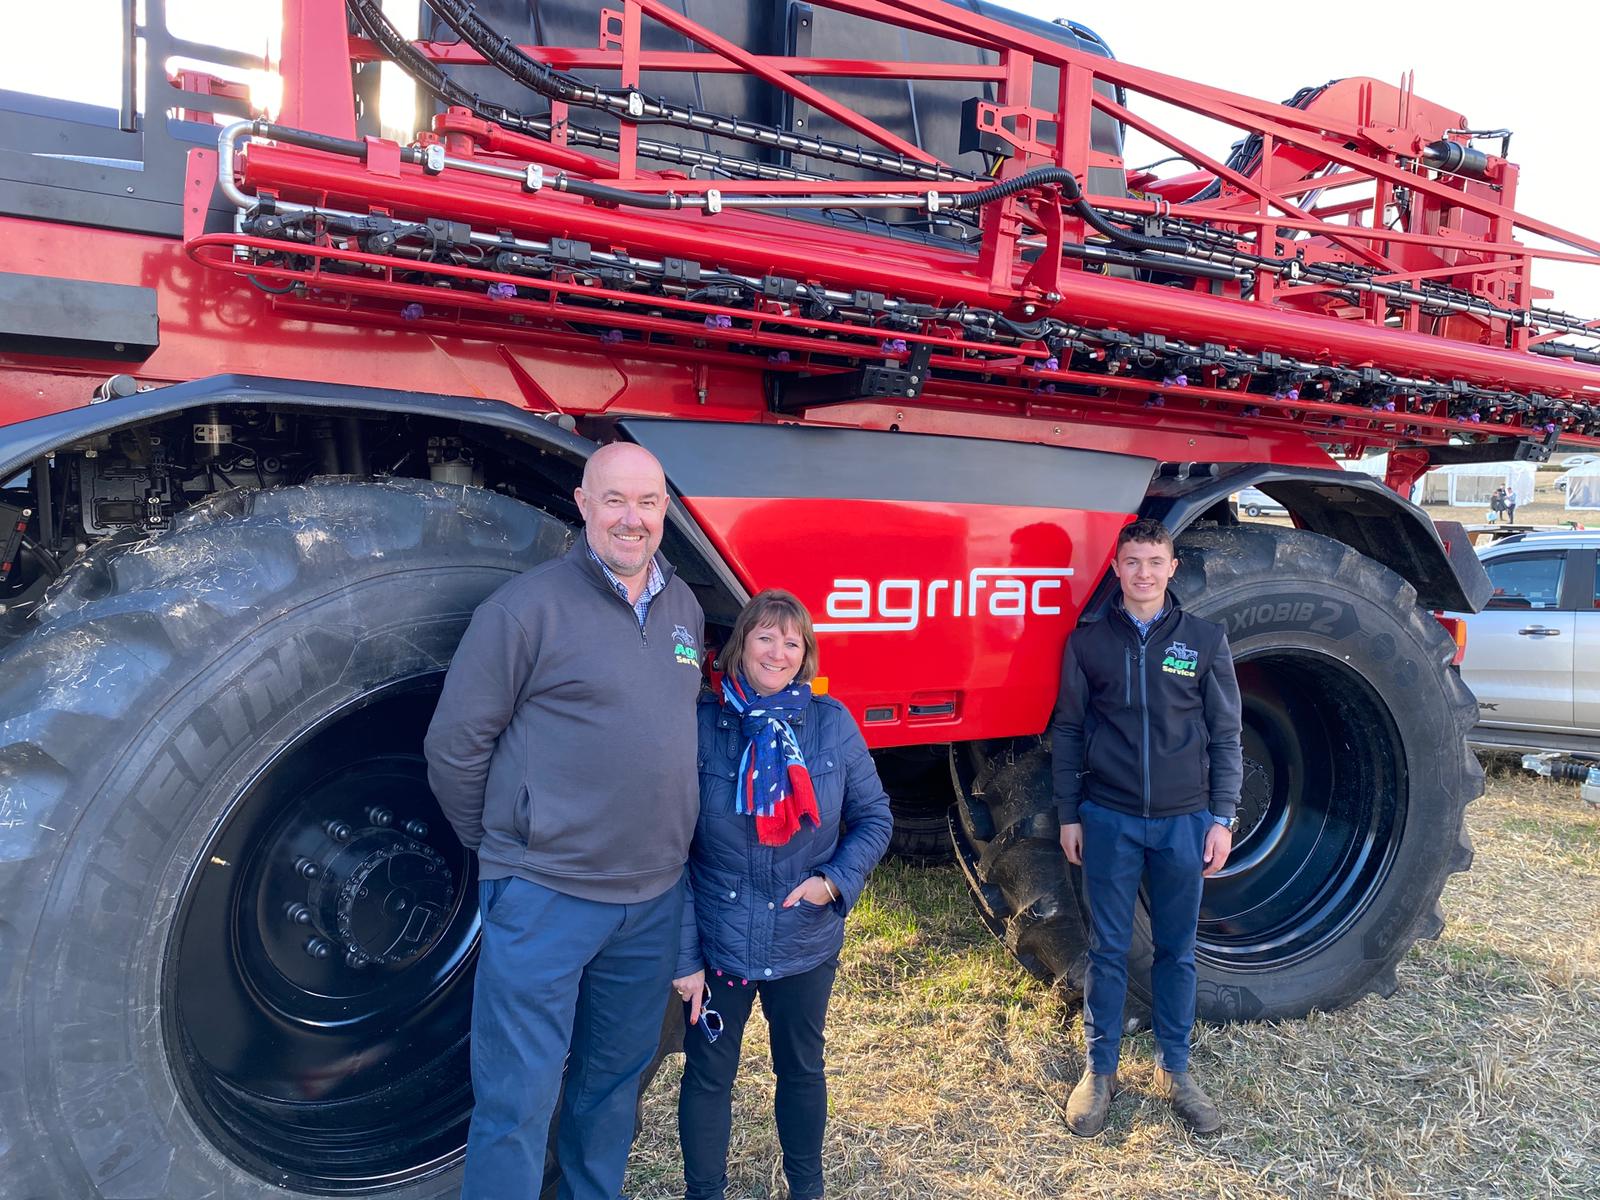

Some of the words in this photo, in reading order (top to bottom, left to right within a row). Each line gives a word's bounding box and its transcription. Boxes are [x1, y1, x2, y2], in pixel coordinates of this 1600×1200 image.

[812, 567, 1075, 633] agrifac
[675, 655, 700, 669] Serv
[1162, 656, 1197, 671] Agri
[1161, 665, 1196, 678] Service
